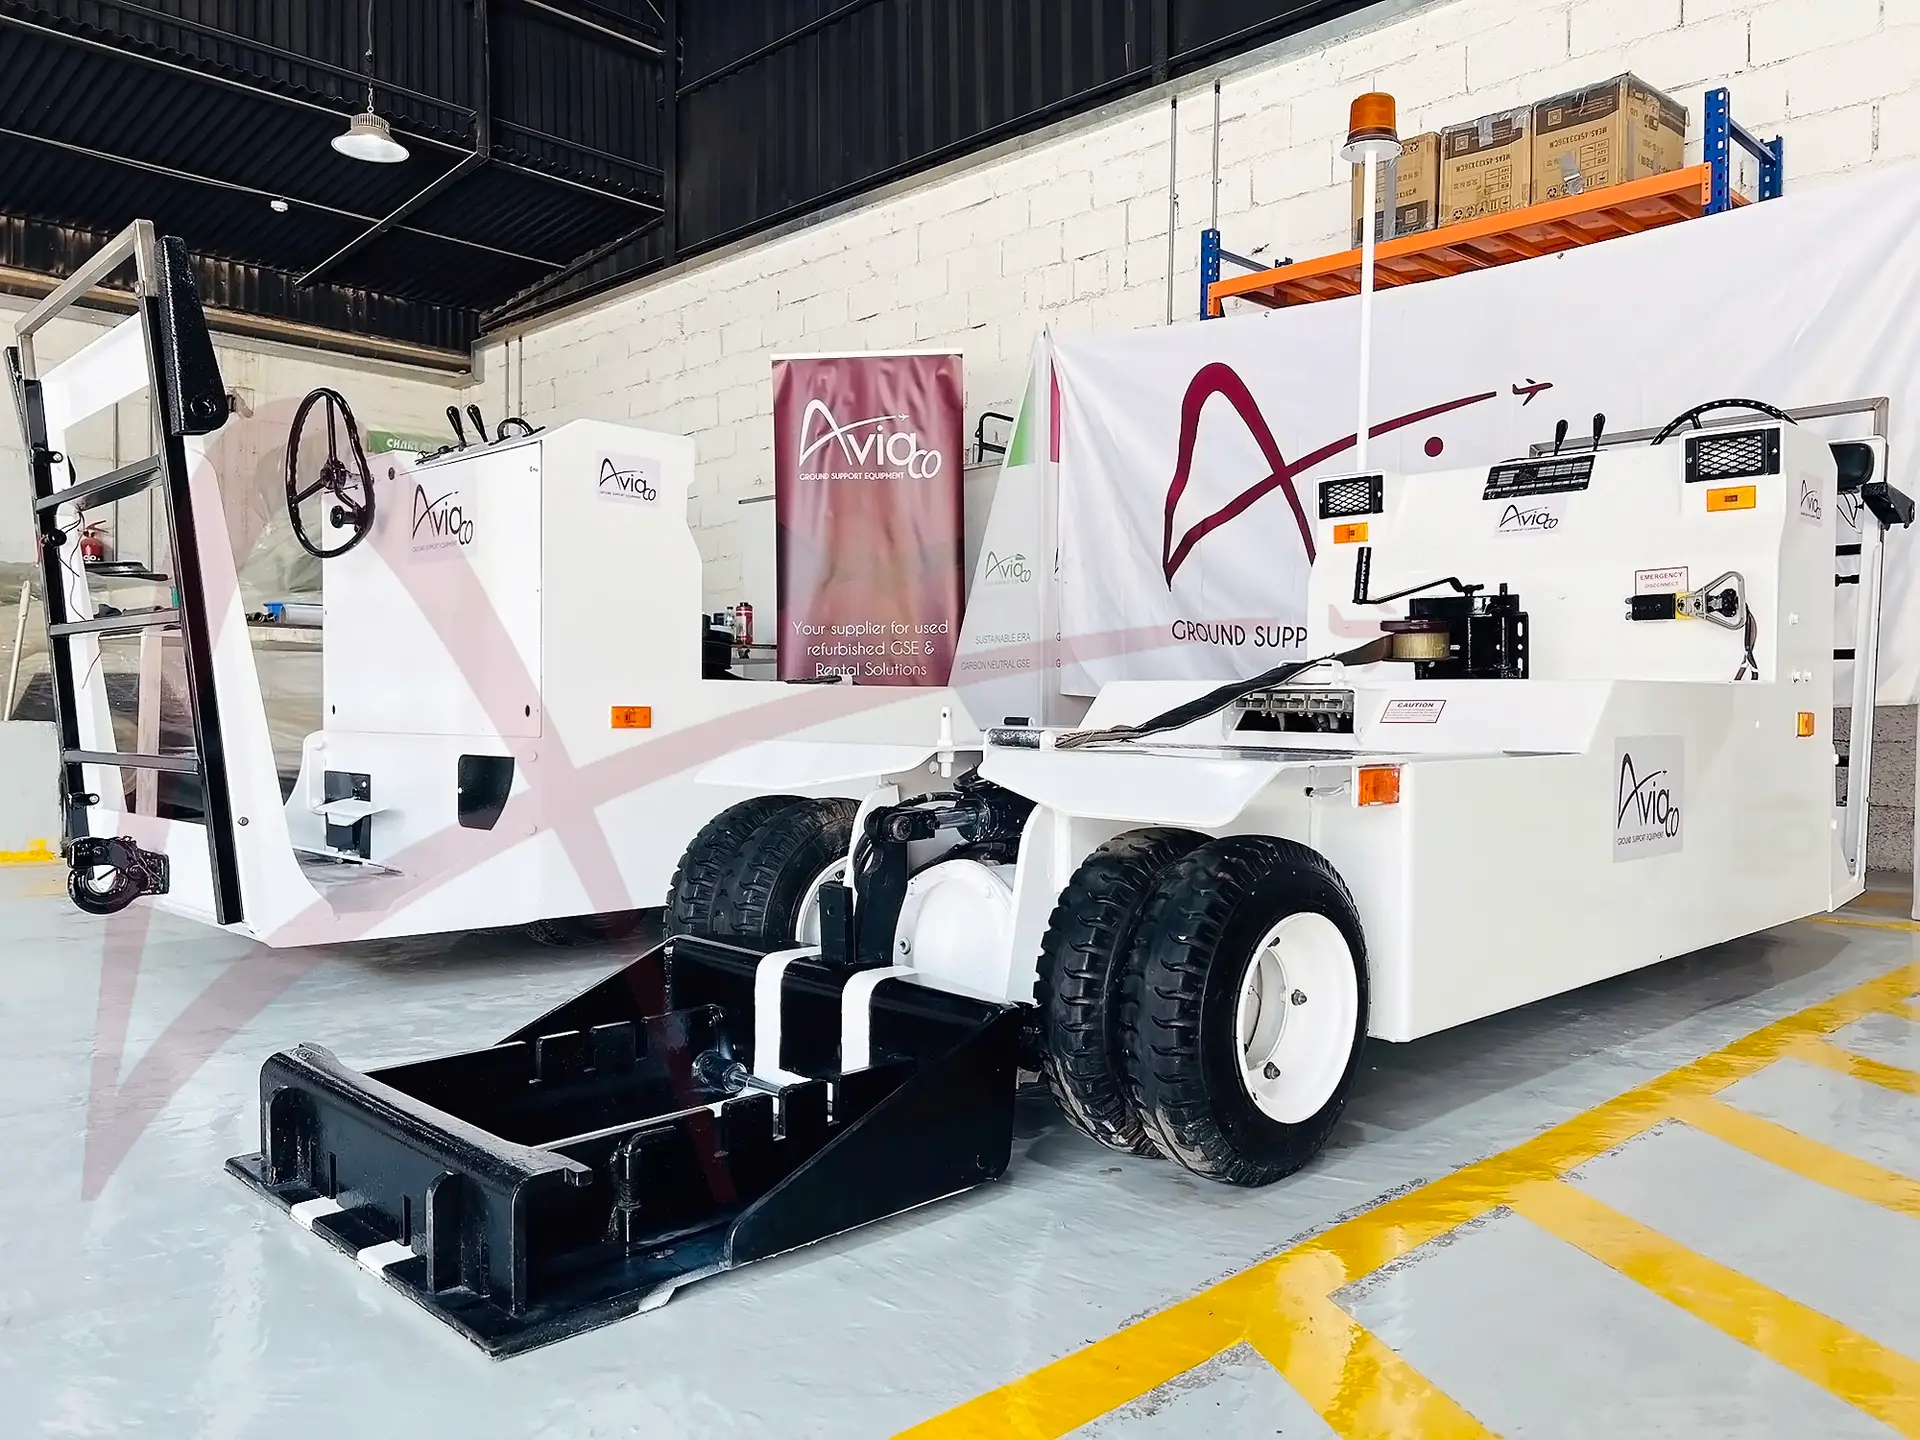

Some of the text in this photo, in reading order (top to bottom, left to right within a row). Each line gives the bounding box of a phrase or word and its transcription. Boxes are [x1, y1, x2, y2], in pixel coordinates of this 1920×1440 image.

[799, 471, 905, 481] GROUND SUPPORT EQUIPMENT
[1640, 571, 1683, 581] EMERGENCY
[1644, 581, 1680, 589] DISCONNECT
[792, 619, 949, 637] Your supplier for used
[1171, 619, 1245, 647] GROUND
[975, 632, 1031, 645] SUSTAINABLE ERA
[807, 640, 935, 656] refurbished GSE &
[815, 662, 927, 677] Rental Solutions
[961, 658, 1030, 671] CARBON NEUTRAL GSE
